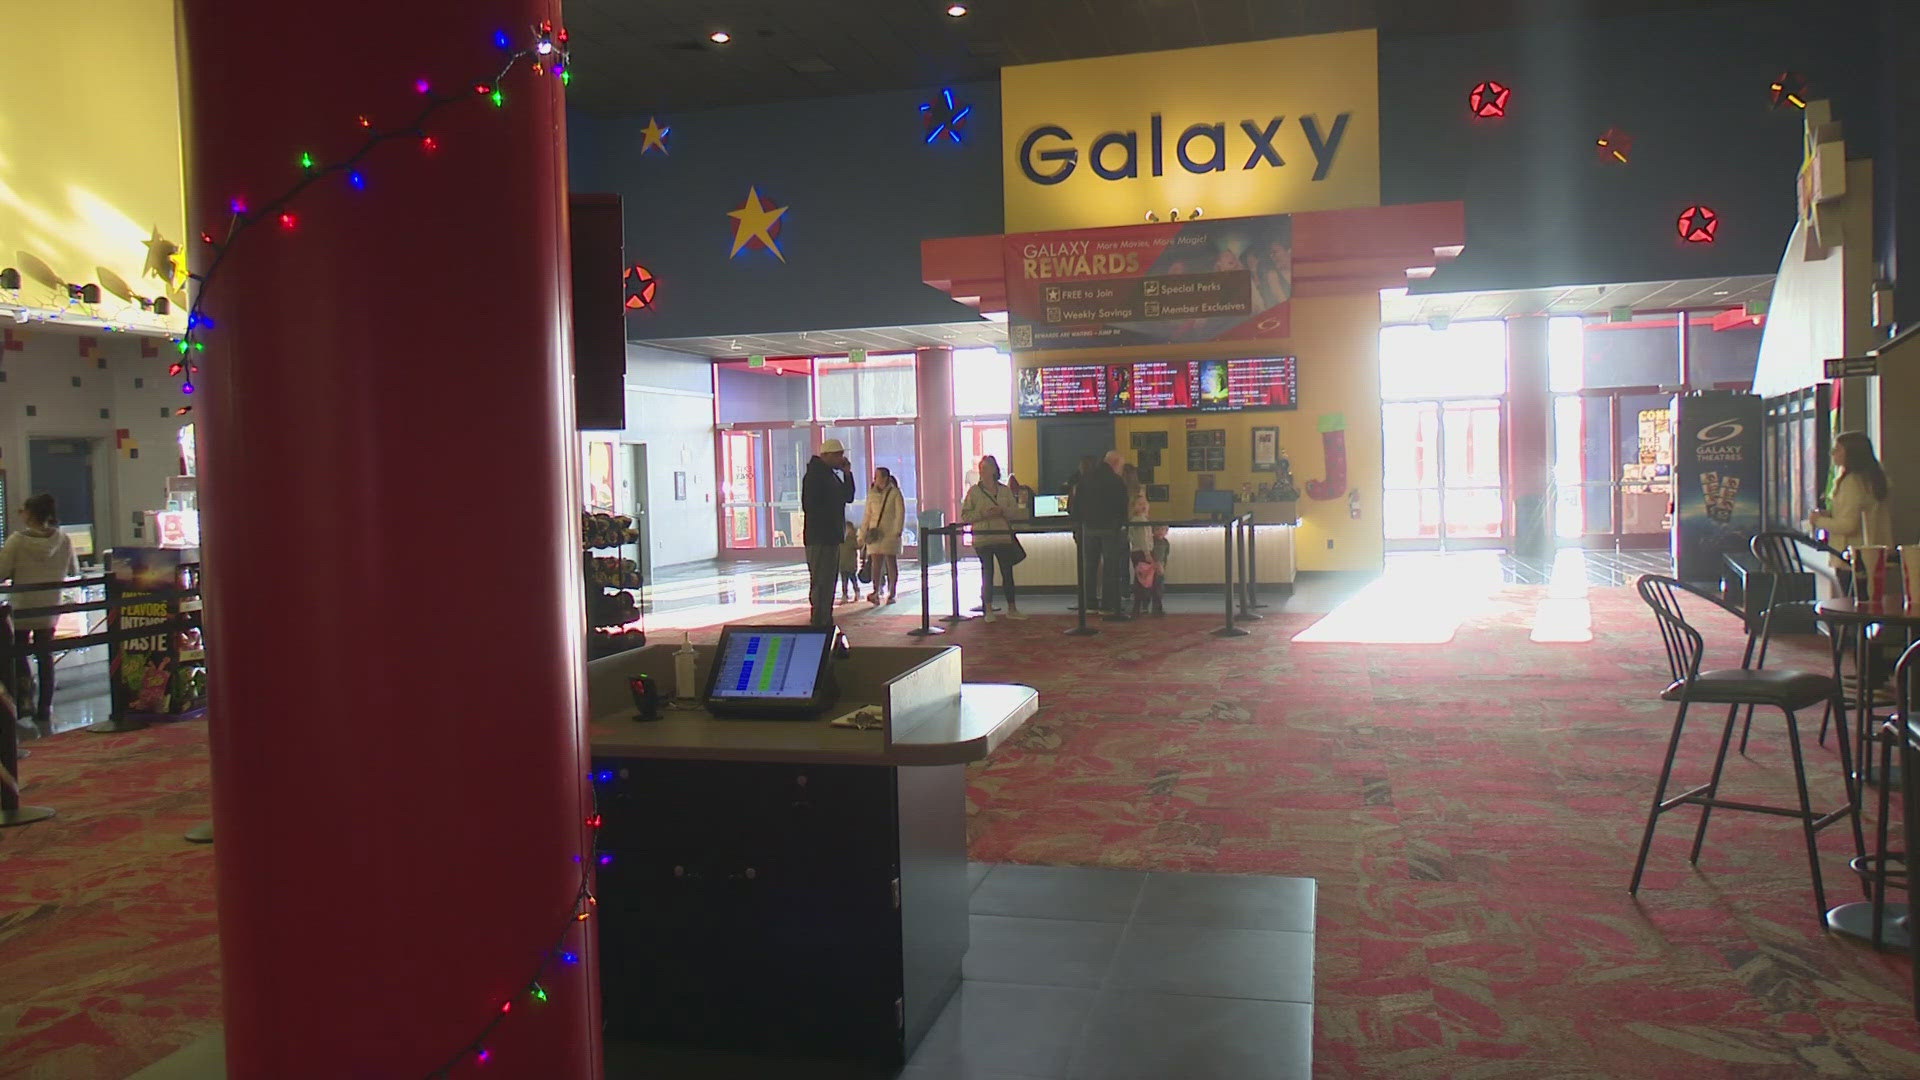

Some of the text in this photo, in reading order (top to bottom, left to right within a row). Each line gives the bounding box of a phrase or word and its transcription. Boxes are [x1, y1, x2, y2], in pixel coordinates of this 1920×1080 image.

[1019, 112, 1350, 186] Galaxy
[1096, 235, 1208, 250] More Movies, More Magic!
[1023, 240, 1090, 259] GALAXY
[1023, 252, 1140, 280] REWARDS
[1062, 289, 1113, 299] FREE to Join
[1161, 282, 1221, 295] Special Perks
[1063, 308, 1132, 320] Weekly Savings
[1161, 302, 1245, 314] Member Exclusives
[1695, 445, 1742, 454] GALAXY
[1696, 453, 1743, 461] THEATRES
[120, 603, 168, 617] FLAVORS
[122, 633, 168, 651] TASTE
